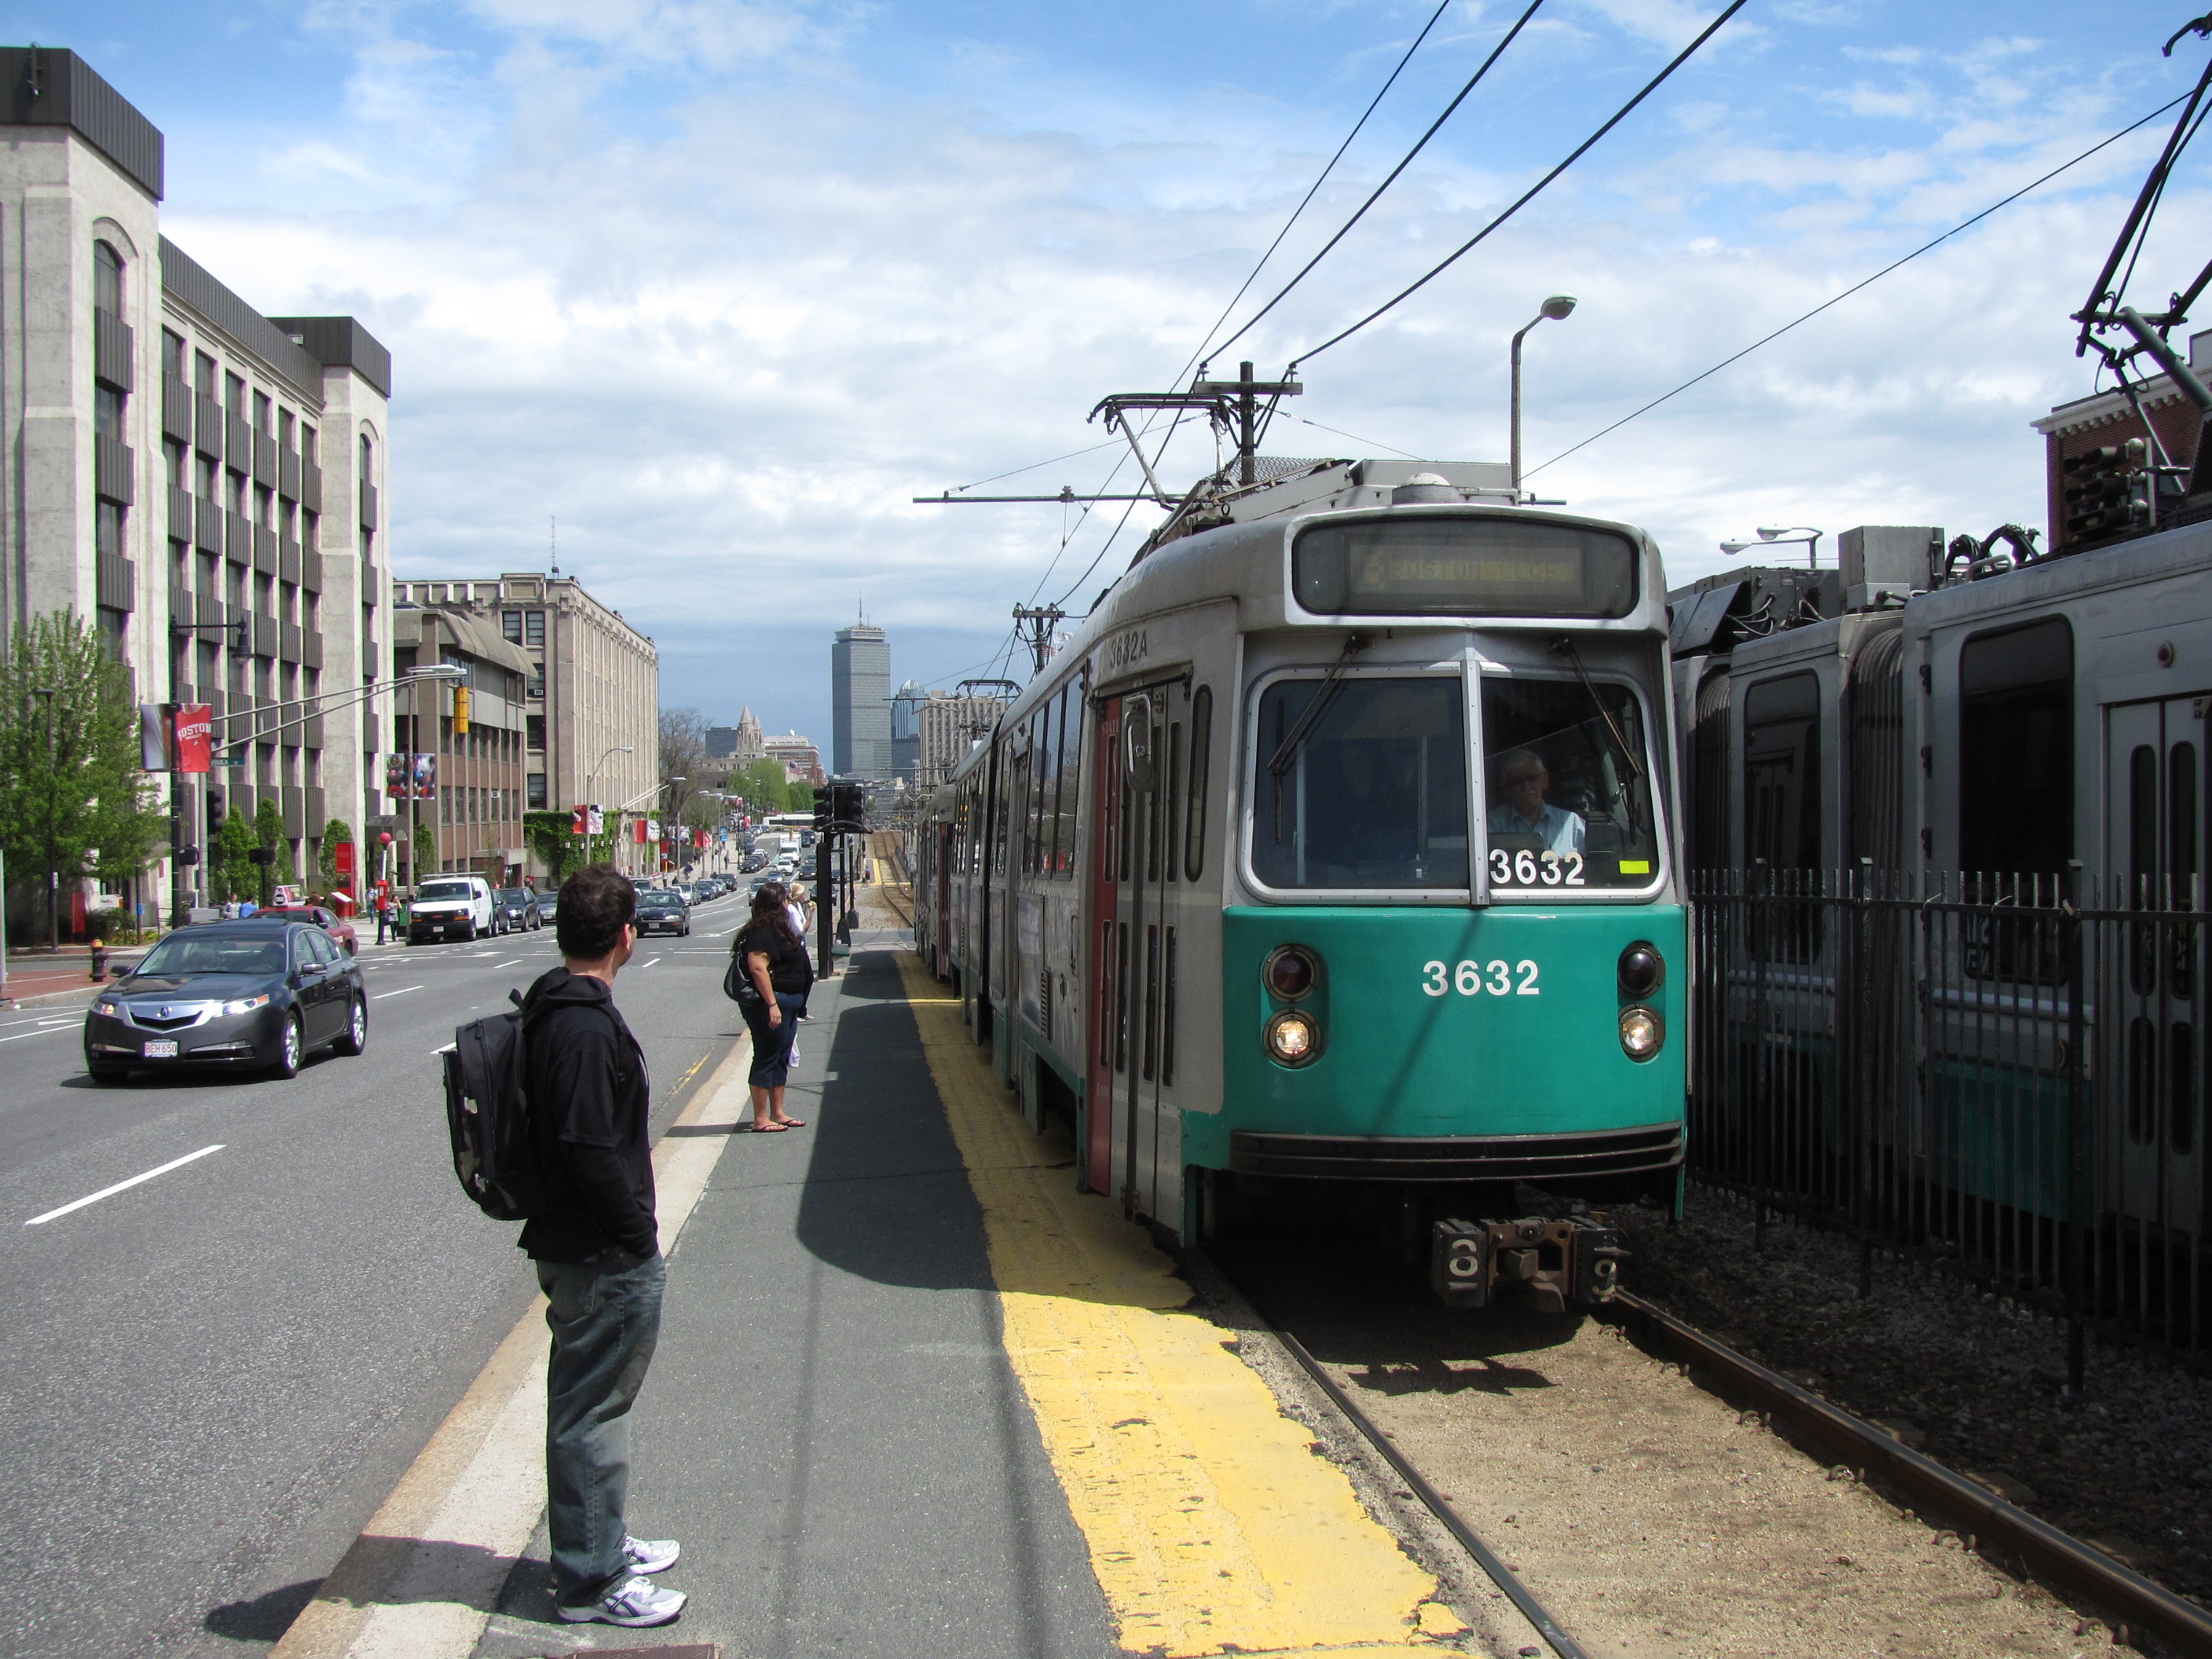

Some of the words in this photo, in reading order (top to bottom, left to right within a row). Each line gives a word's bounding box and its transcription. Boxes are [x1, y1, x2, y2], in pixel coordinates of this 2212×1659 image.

[1110, 631, 1148, 668] 3632A
[1101, 720, 1120, 736] STATE
[1489, 848, 1585, 885] 3632
[1422, 959, 1540, 997] 3632
[162, 1044, 177, 1053] 650
